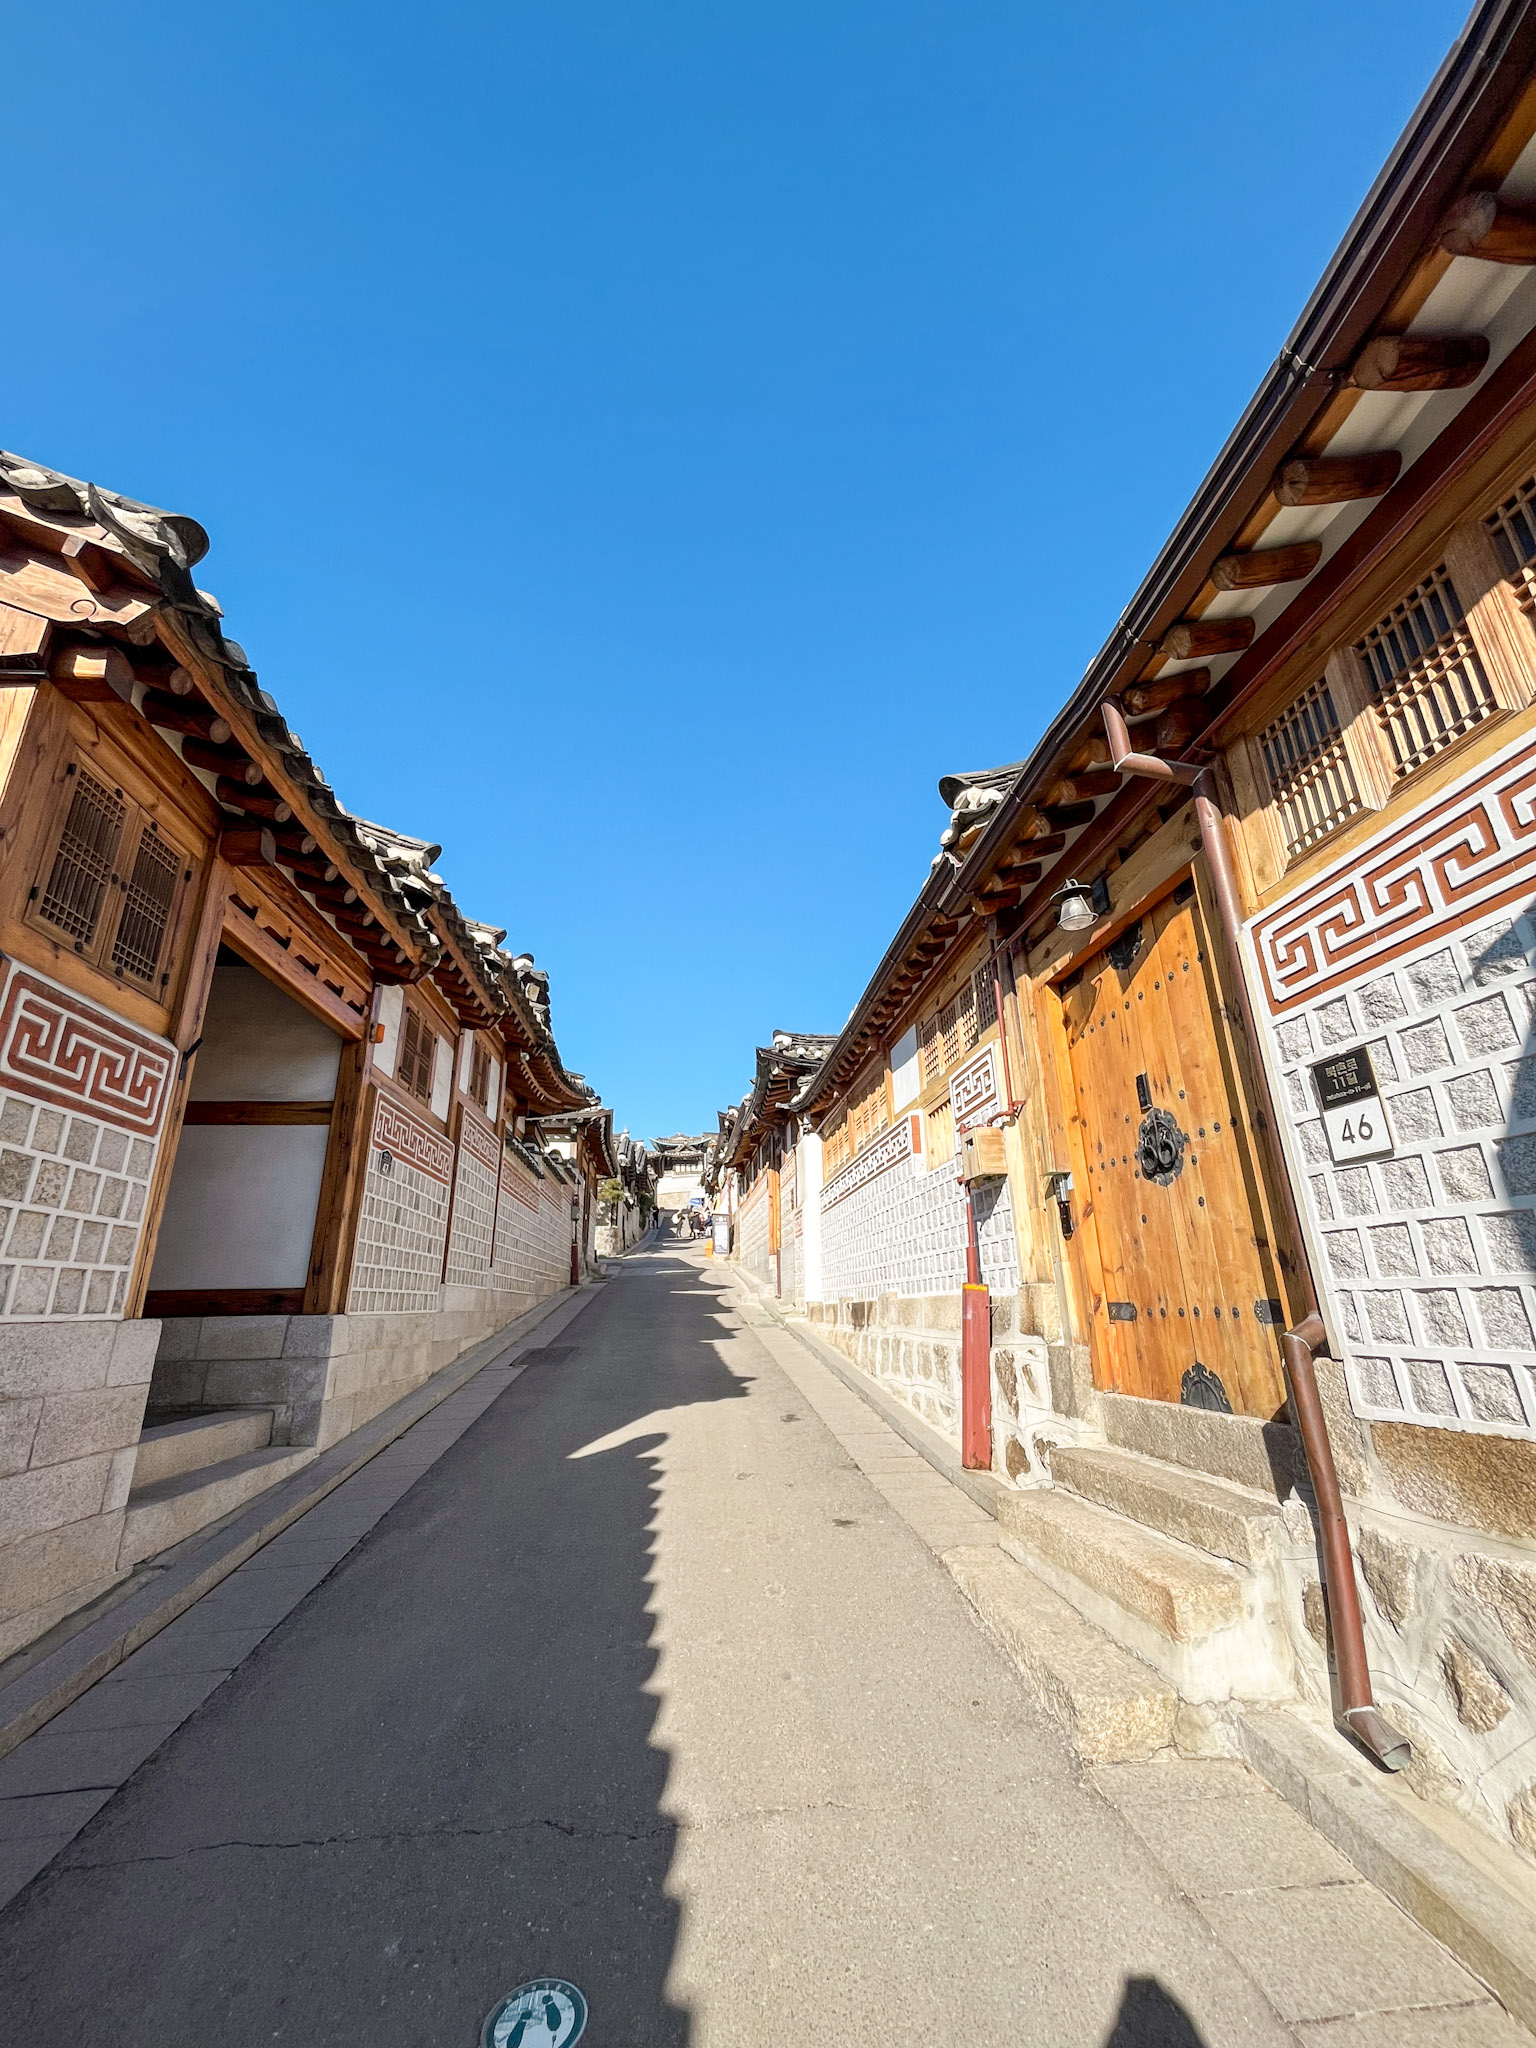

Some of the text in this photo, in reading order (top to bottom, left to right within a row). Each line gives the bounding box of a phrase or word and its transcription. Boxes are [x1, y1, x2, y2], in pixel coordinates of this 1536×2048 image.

[1325, 1058, 1358, 1077] 북촌로
[1332, 1071, 1358, 1090] 11길
[1341, 1113, 1374, 1144] 46
